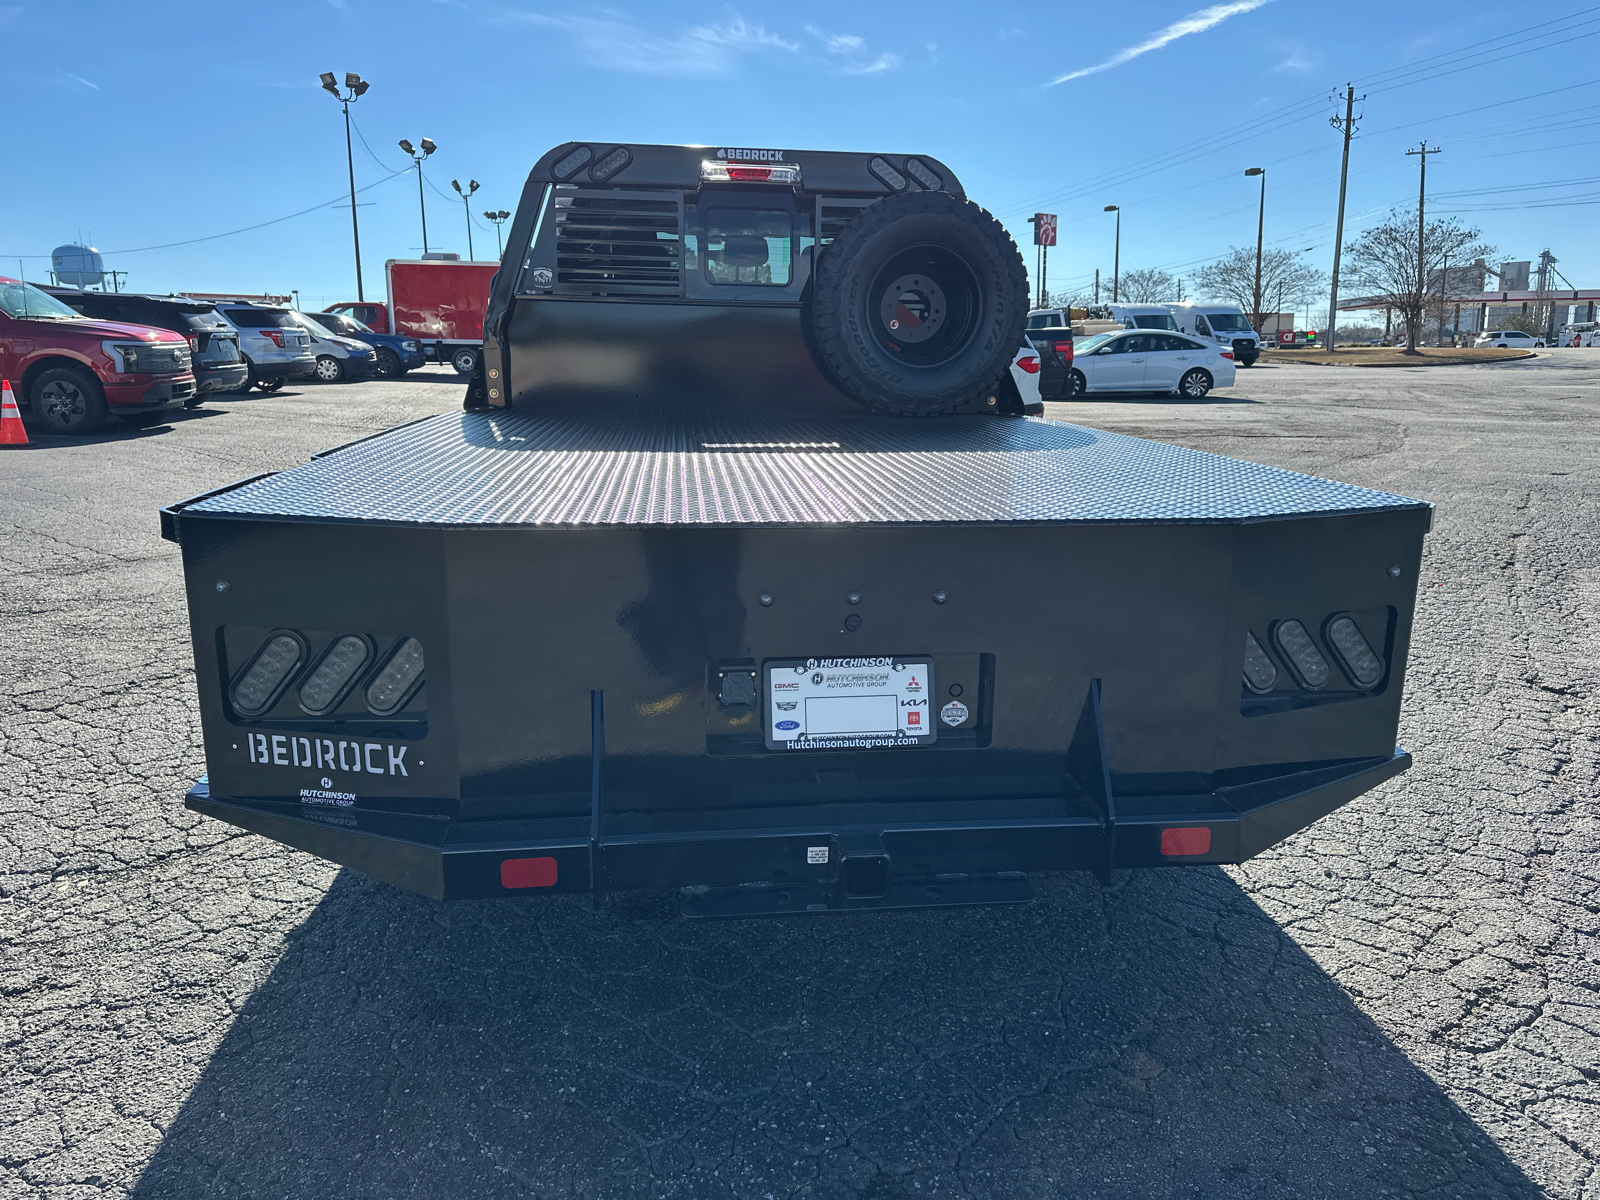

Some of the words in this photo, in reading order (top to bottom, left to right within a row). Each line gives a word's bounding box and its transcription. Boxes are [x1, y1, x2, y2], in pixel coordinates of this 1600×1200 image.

[728, 149, 783, 161] BEDROCK
[820, 657, 893, 668] HUTCHINSON
[825, 672, 889, 682] HUTCHINSON
[786, 737, 918, 750] Hutchinsonautogroup.com
[248, 732, 408, 777] BEDROCK
[300, 789, 355, 800] HUTCHINSON
